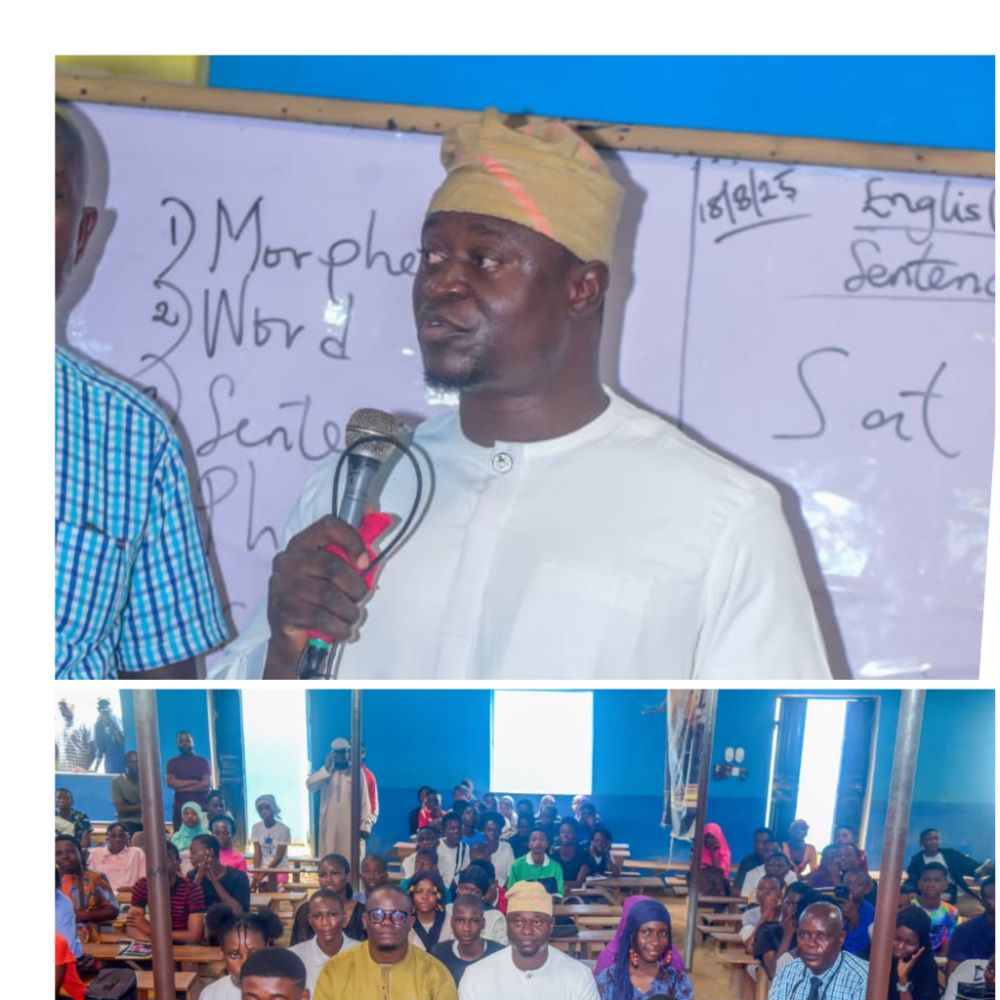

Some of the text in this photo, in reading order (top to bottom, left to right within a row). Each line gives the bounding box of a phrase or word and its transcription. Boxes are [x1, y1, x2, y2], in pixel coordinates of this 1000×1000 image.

[700, 168, 798, 224] 18/8/25
[208, 196, 422, 305] Morphe
[204, 274, 354, 360] Word
[196, 374, 346, 461] Sente
